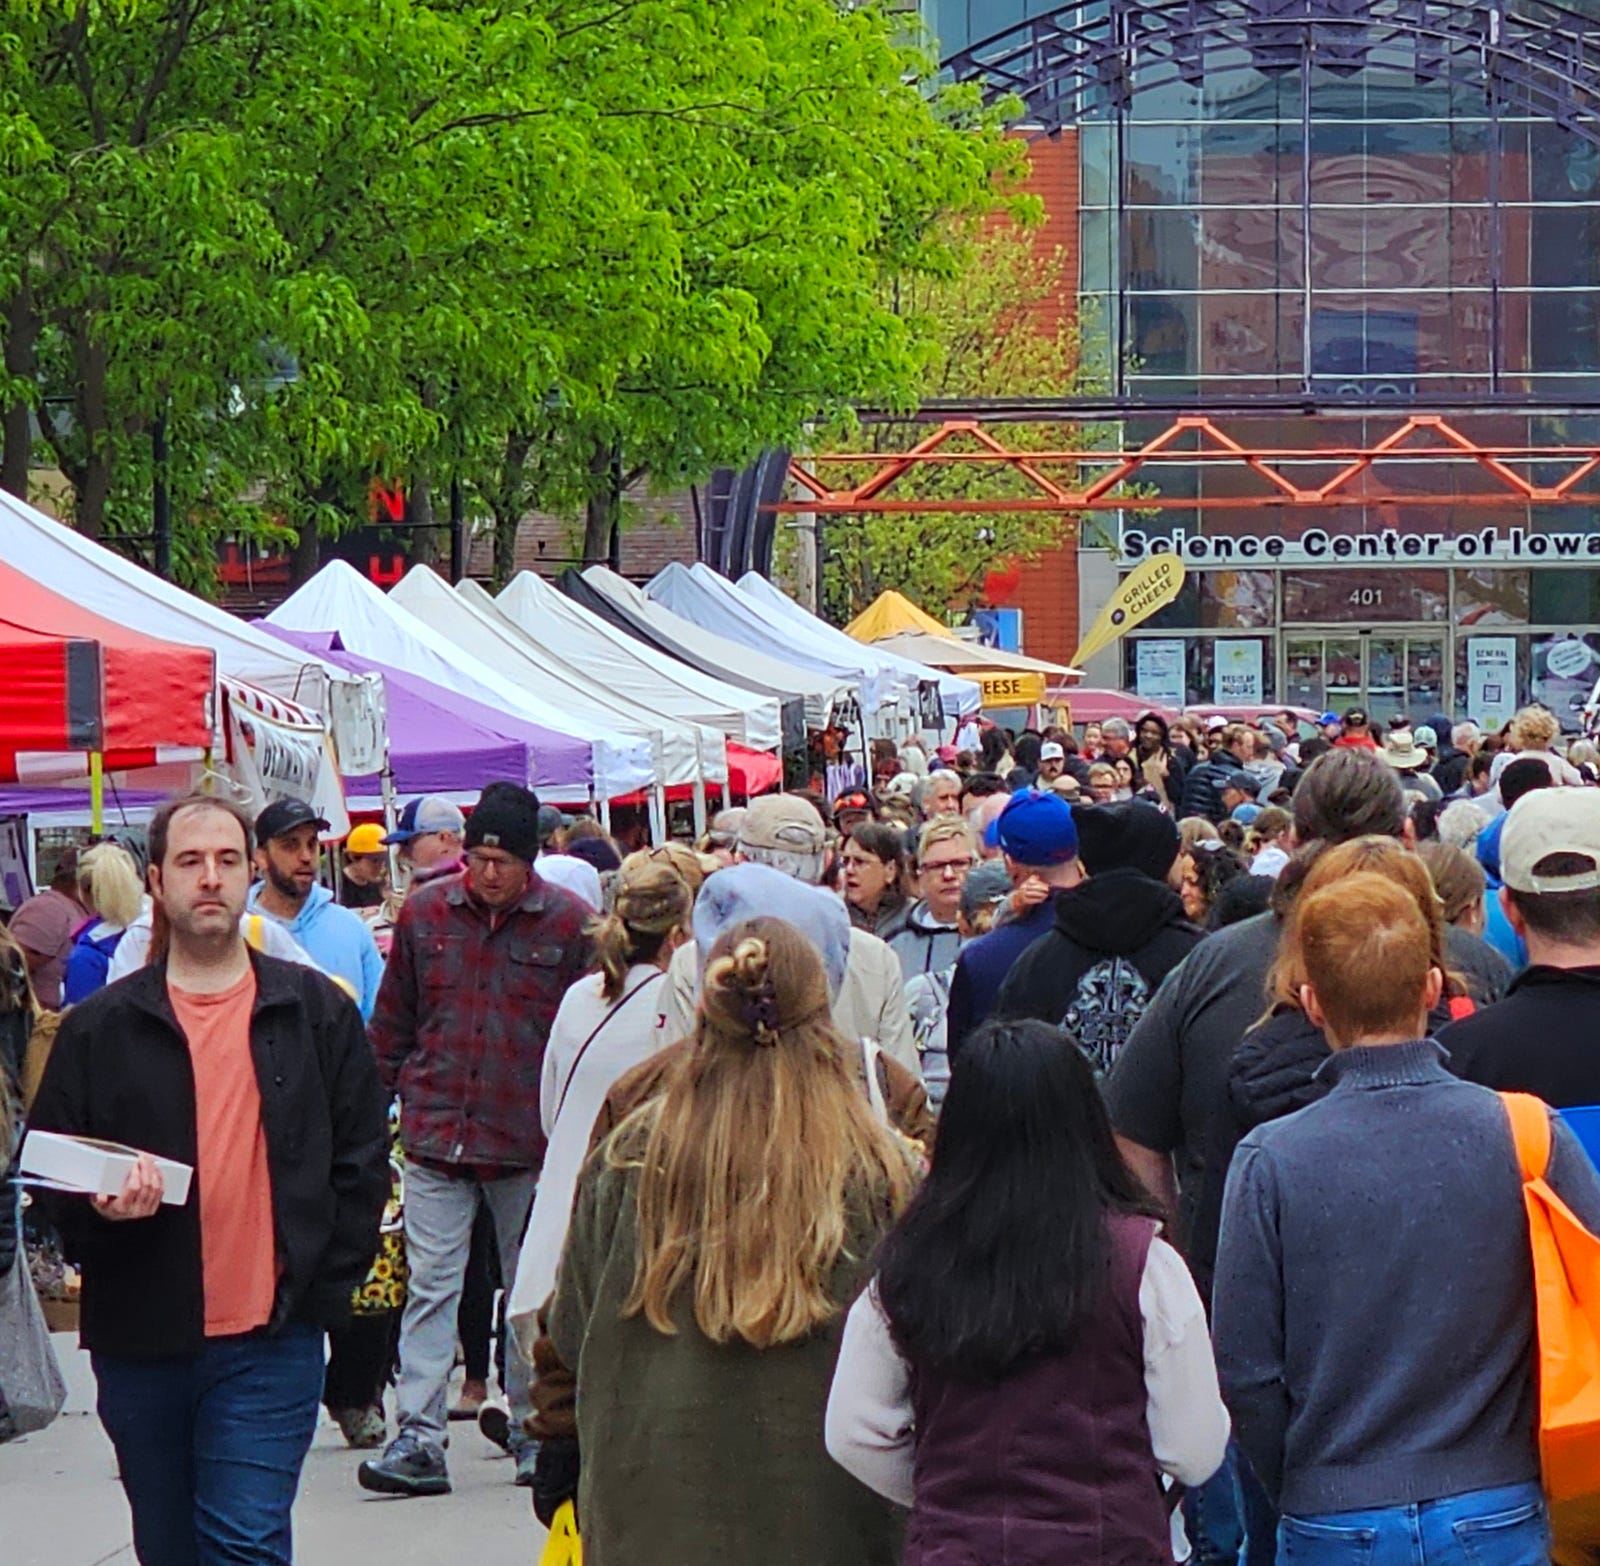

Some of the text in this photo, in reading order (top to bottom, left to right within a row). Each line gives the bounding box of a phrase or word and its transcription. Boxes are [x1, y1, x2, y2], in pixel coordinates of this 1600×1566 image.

[1123, 530, 1286, 559] Science
[1303, 530, 1442, 557] Center
[1457, 529, 1497, 556] of
[1123, 563, 1170, 604] GRILLED
[1130, 576, 1173, 614] CHEESE
[1349, 588, 1383, 605] 401
[1222, 685, 1256, 696] HOURS
